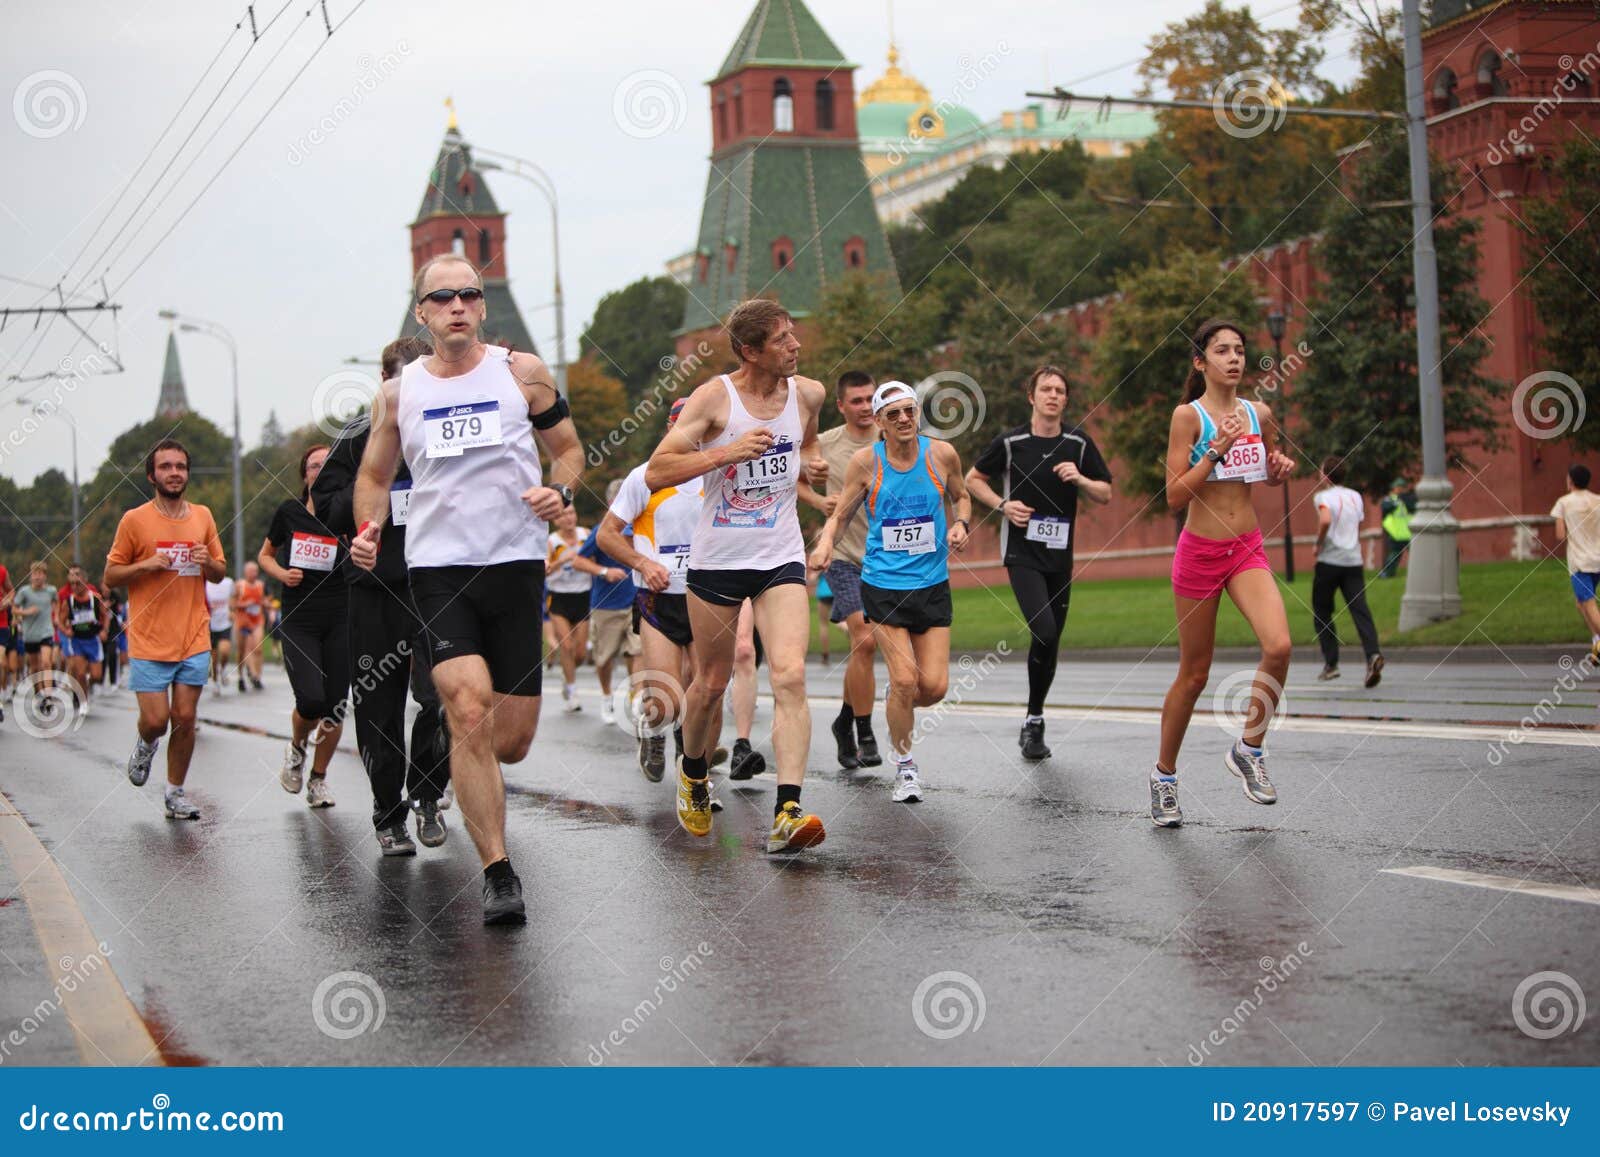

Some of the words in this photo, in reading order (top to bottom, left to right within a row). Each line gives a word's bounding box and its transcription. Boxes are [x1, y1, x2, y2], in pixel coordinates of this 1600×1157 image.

[442, 417, 482, 440] 879
[746, 456, 787, 477] 1133
[1223, 447, 1260, 468] 2865
[893, 526, 922, 543] 757
[1037, 523, 1060, 537] 631
[295, 542, 330, 559] 2985
